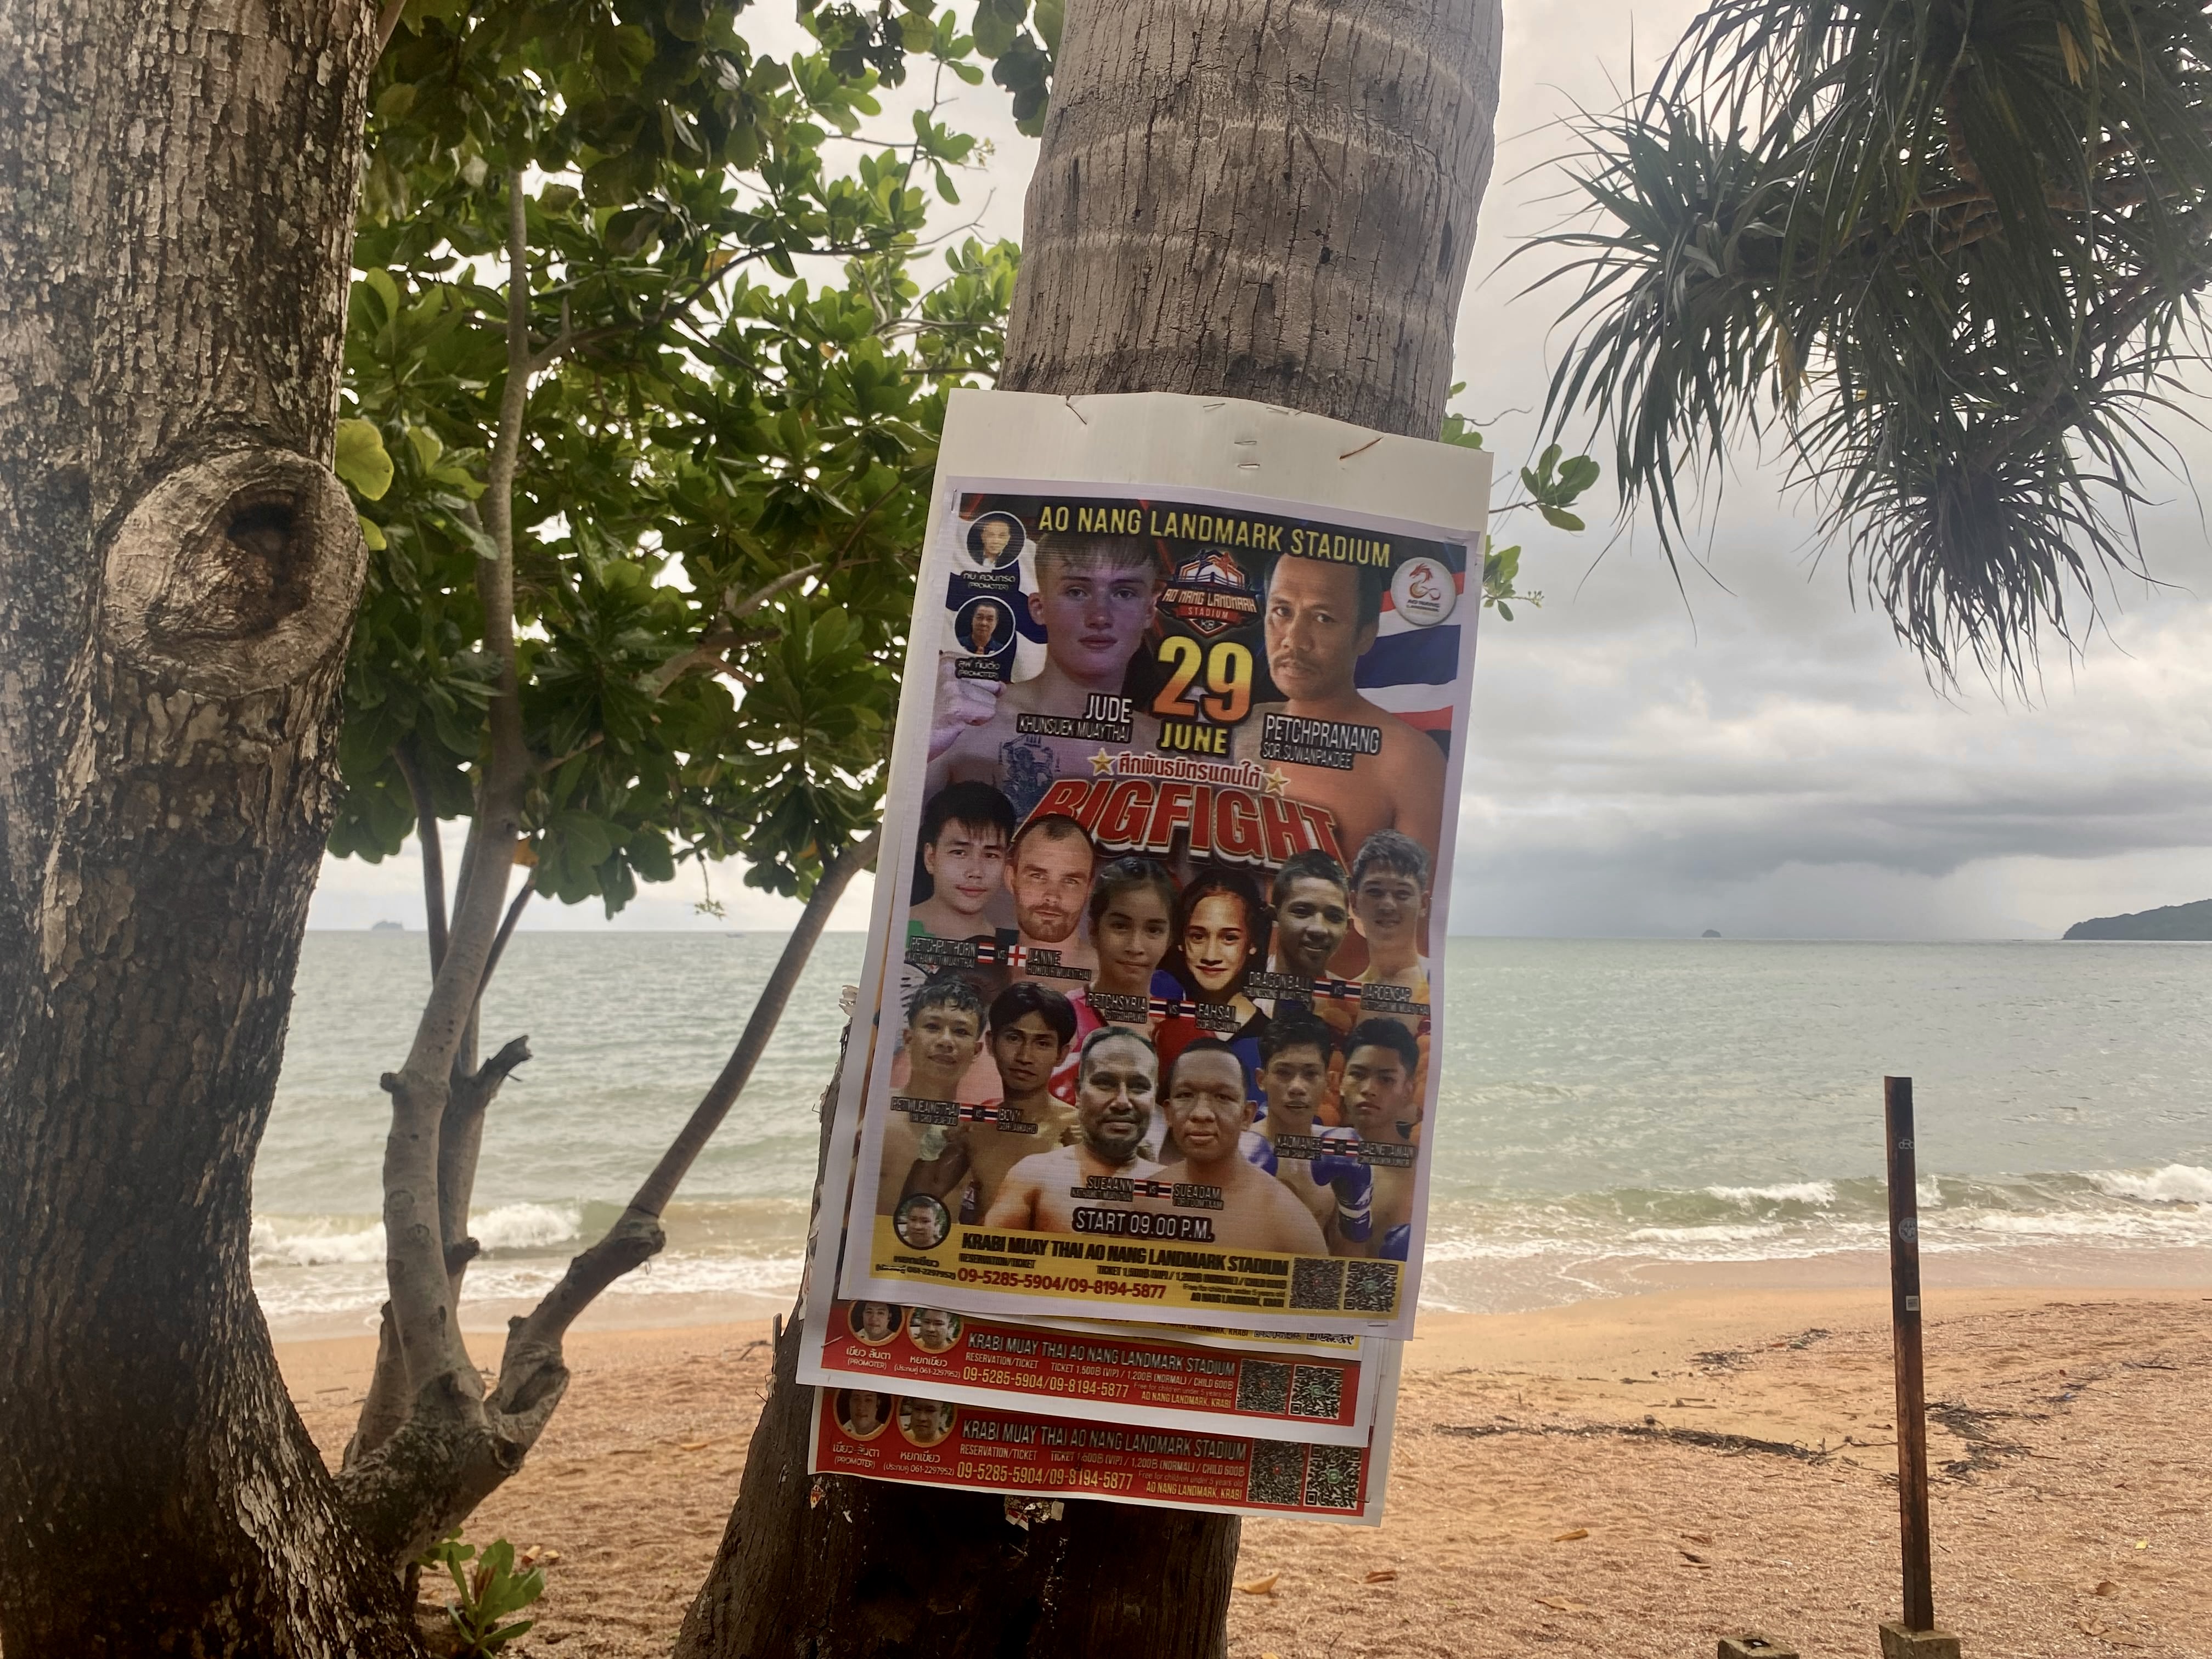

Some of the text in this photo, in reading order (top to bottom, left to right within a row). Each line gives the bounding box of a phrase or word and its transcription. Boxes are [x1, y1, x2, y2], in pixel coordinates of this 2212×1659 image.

[1039, 506, 1390, 568] AO NANG LANDMARK STADIUM
[968, 582, 1009, 591] (PROMOTER)
[1162, 589, 1178, 602] AO
[1178, 591, 1205, 605] NANG
[1207, 593, 1257, 613] LANDMARK
[1188, 607, 1229, 619] STADIUM
[1153, 636, 1254, 721] 29
[1086, 695, 1132, 723] JUDE
[1019, 715, 1130, 742] KHUNSUEK MUAYTHAI
[1160, 722, 1228, 754] JUNE
[1265, 715, 1380, 754] PETCHPRANANG
[1088, 992, 1146, 1011] PETCHSYRIA
[1199, 1003, 1235, 1020] FAHSAI
[1173, 1184, 1221, 1200] SUEADAM
[1076, 1210, 1212, 1239] START 09.00 P.M.
[962, 1232, 1289, 1276] KRABI MUAY THAI AO NANG LANDMARK STADIUM
[958, 1267, 1166, 1299] 09-5285-5904/09-8194-5877
[848, 1358, 887, 1369] (PROMOTER)
[968, 1332, 1235, 1376] KRABI MUAY THAI AO NANG LANDMARK STADIUM
[963, 1366, 1129, 1398] 09-5285-5904/09-8194-5877
[966, 1352, 1039, 1369] RESERVATION/TICKET
[1051, 1362, 1074, 1373] TICKET
[1103, 1367, 1119, 1378] (VIP)
[1120, 1369, 1125, 1379] /
[1154, 1373, 1186, 1385] (NORMAL)
[1188, 1377, 1192, 1386] /
[1194, 1377, 1214, 1388] CHILD
[1142, 1391, 1150, 1401] AO
[1152, 1392, 1170, 1403] NANG
[1211, 1398, 1231, 1409] KRABI
[962, 1419, 1247, 1461] KRABI MUAY THAI AO NANG LANDMARK STADIUM
[834, 1455, 876, 1470] (PROMOTER)
[910, 1464, 955, 1476] 061-2297952)
[960, 1443, 1038, 1461] RESERVATION/TICKET
[1051, 1451, 1075, 1462] TICKET
[1105, 1455, 1122, 1466] (VIP)
[1124, 1457, 1128, 1466] /
[1160, 1460, 1195, 1473] (NORMAL)
[1196, 1464, 1201, 1473] /
[1202, 1464, 1223, 1475] CHILD
[957, 1461, 1133, 1491] 09-5285-5904/09-8194-5877
[1138, 1470, 1152, 1479] Free
[1154, 1471, 1164, 1480] for
[1164, 1473, 1188, 1482] children
[1190, 1476, 1208, 1484] under
[1215, 1479, 1233, 1488] years
[1233, 1479, 1243, 1487] old
[1146, 1481, 1243, 1500] AO NANG LANDMARK, KRABI
